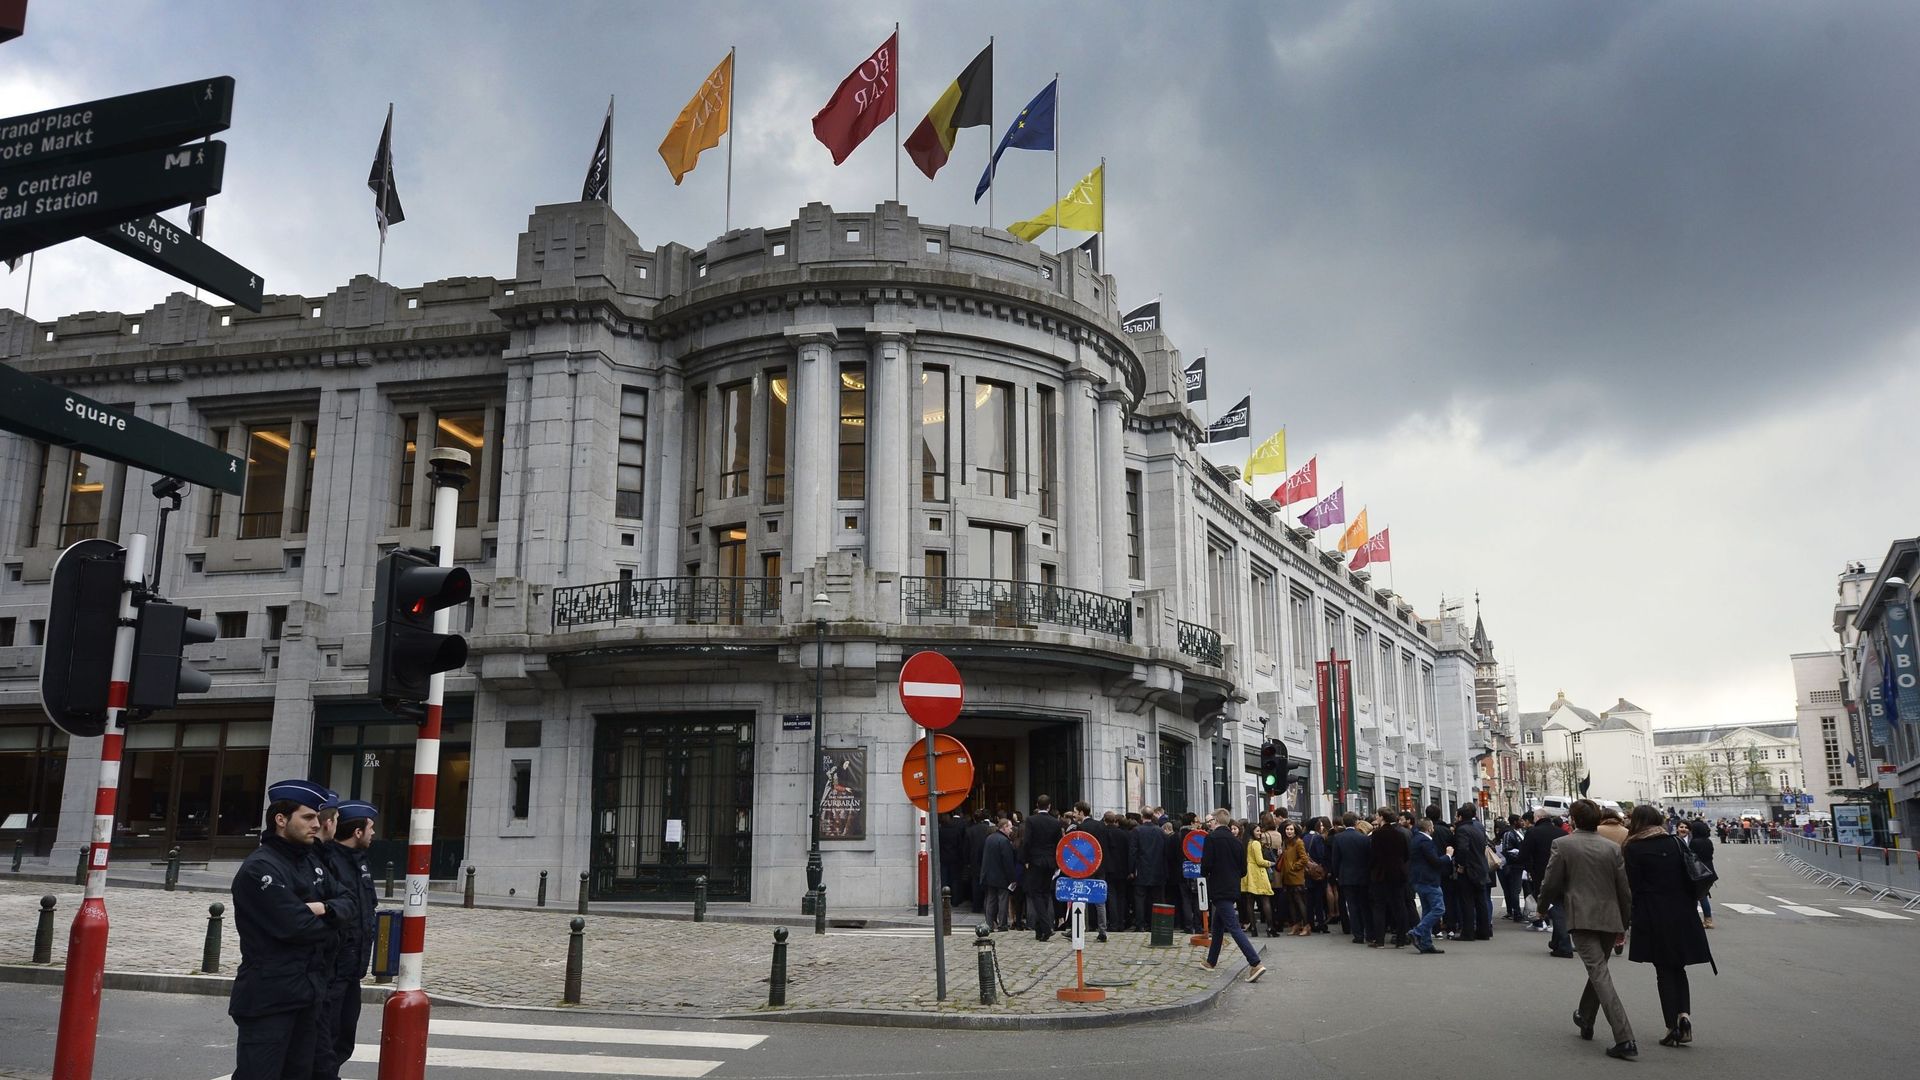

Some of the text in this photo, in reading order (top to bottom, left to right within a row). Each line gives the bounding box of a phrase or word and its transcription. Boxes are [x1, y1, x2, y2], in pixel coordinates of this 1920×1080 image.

[0, 110, 93, 140] rand'Place
[41, 128, 94, 153] Markt
[18, 170, 92, 196] Centrale
[35, 190, 98, 214] Station
[148, 218, 180, 245] Arts
[65, 397, 126, 431] Square
[1892, 634, 1916, 688] VBO
